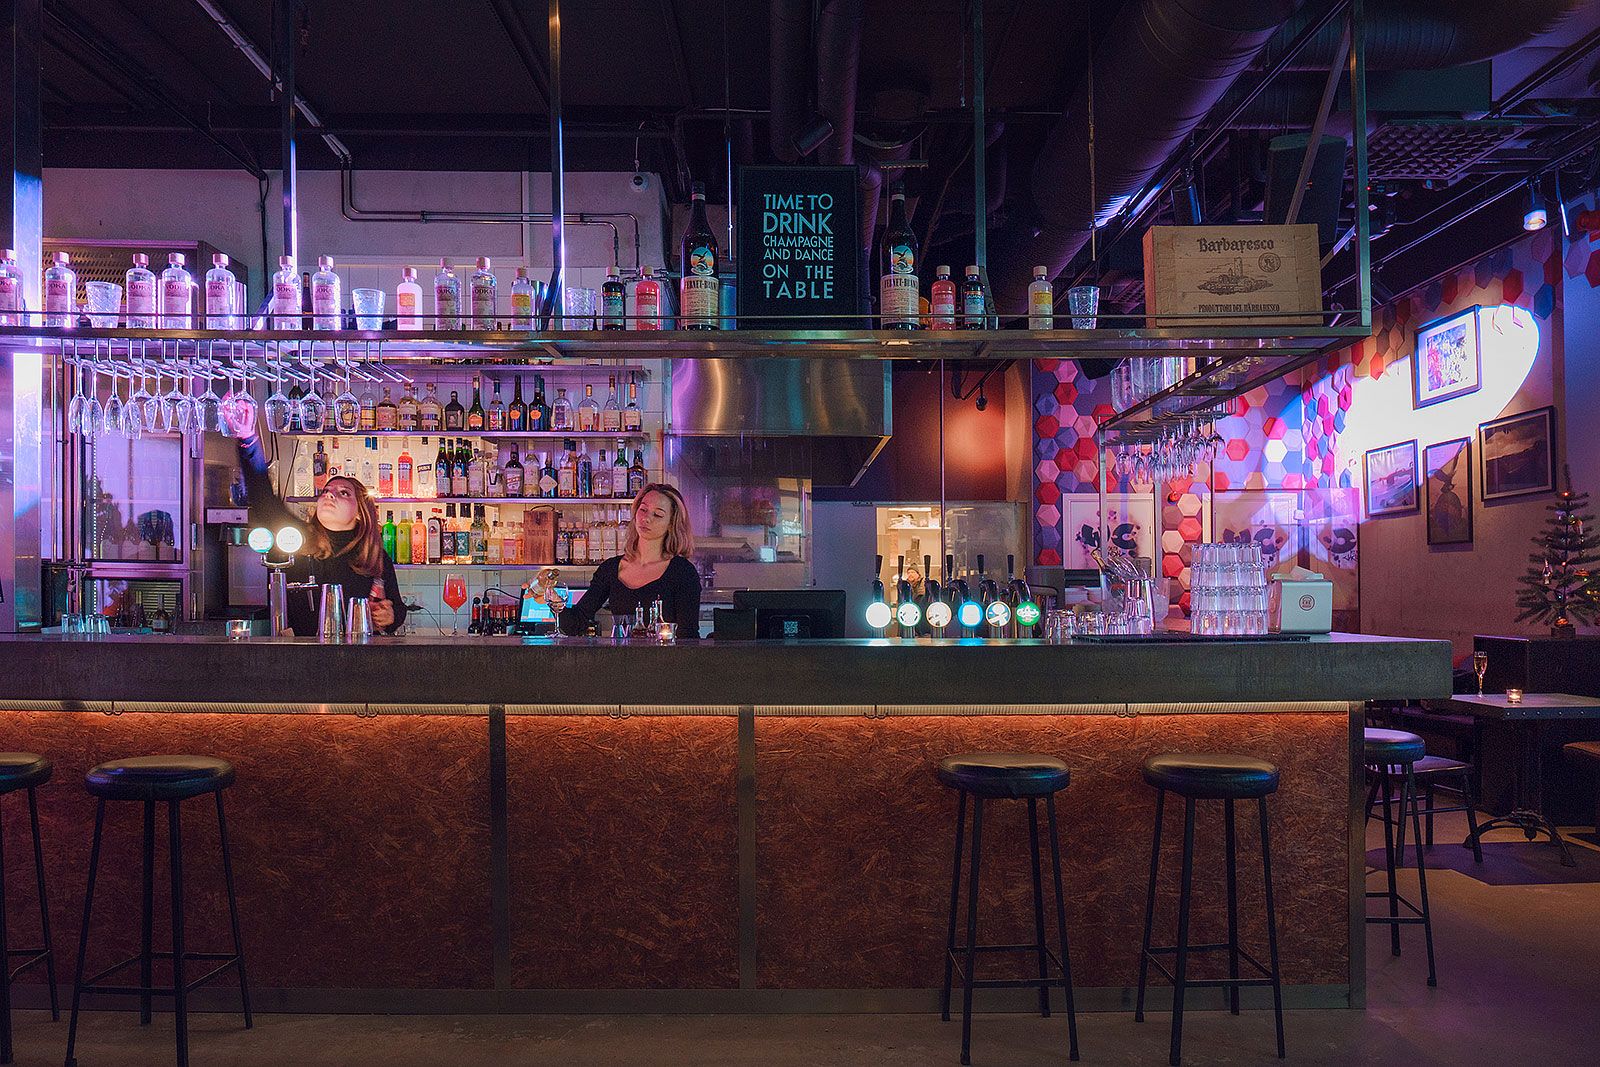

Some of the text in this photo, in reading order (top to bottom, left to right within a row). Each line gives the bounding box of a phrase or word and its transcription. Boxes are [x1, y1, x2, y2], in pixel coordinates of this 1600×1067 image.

[764, 193, 833, 210] TIME TO
[763, 212, 833, 234] DRINK
[763, 235, 833, 247] CHAMPAGNE
[1197, 237, 1274, 254] Barbaresco
[763, 248, 833, 260] AND DANCE
[763, 264, 833, 279] ON THE
[763, 281, 833, 298] TABLE
